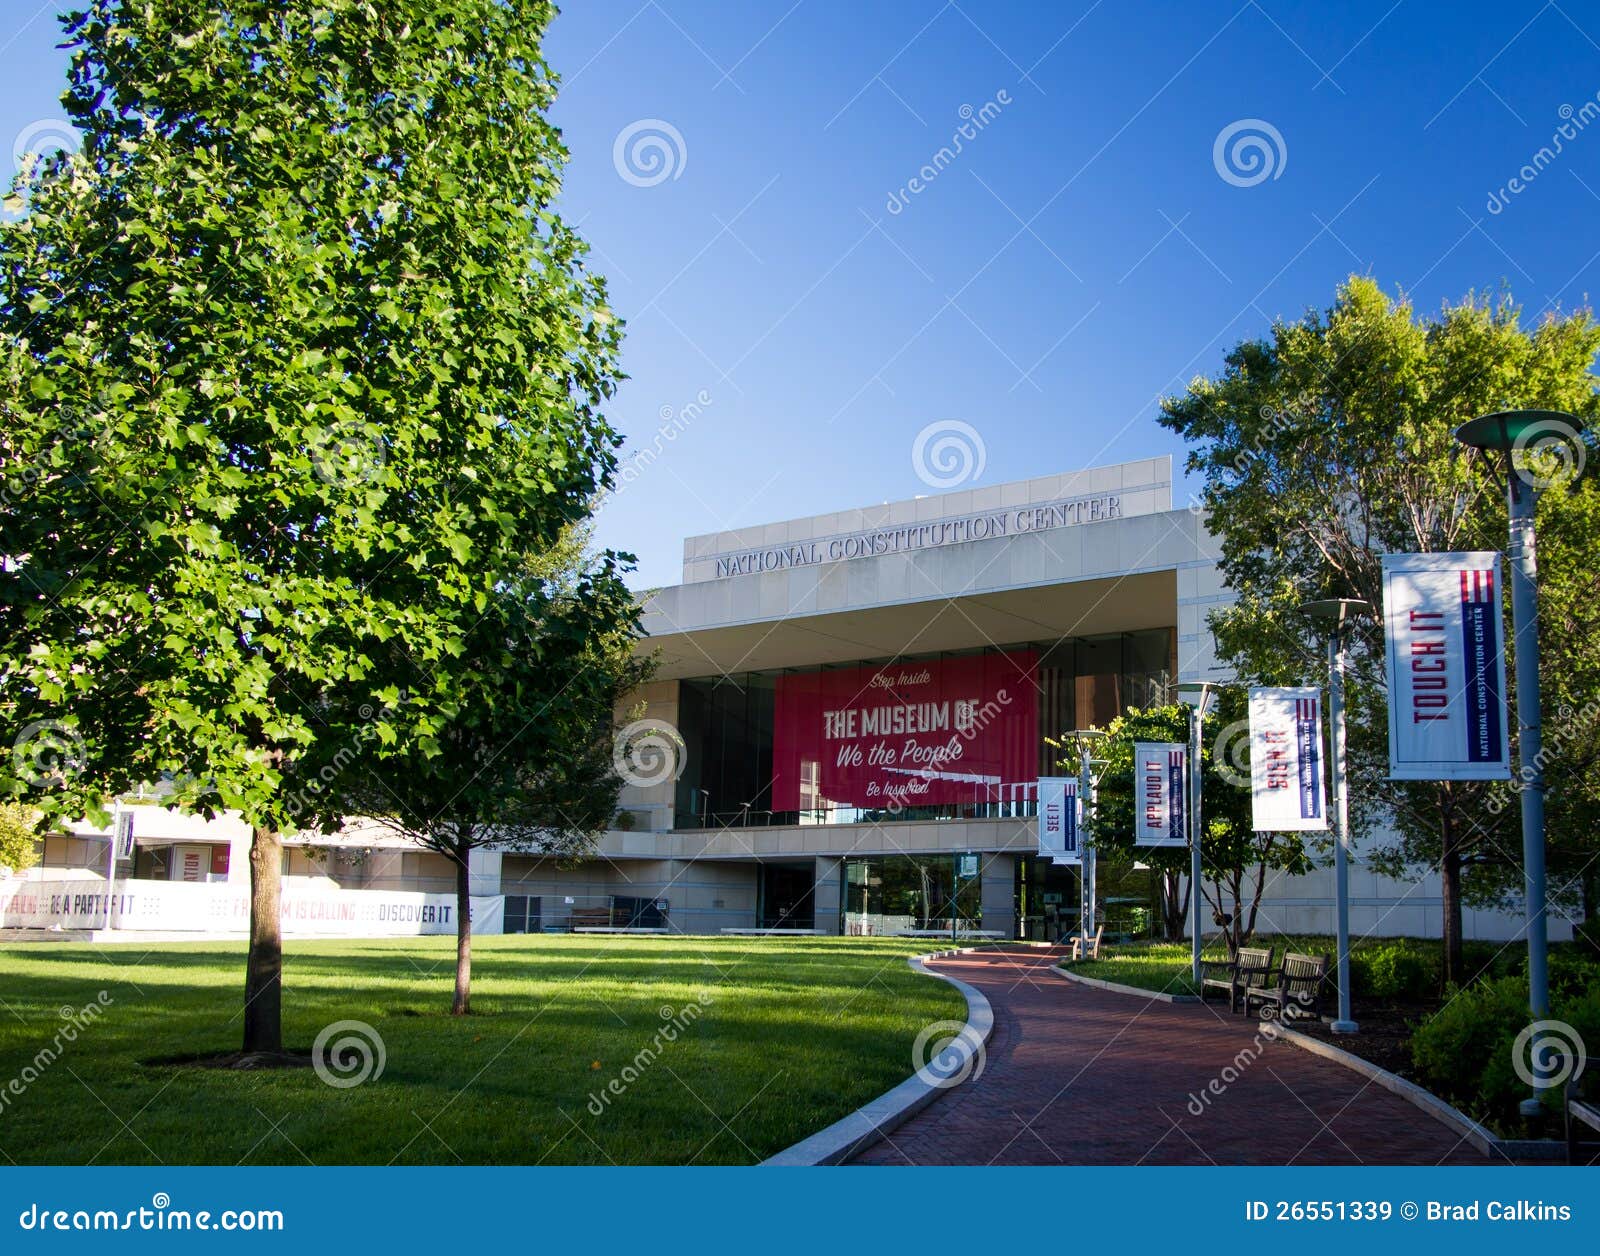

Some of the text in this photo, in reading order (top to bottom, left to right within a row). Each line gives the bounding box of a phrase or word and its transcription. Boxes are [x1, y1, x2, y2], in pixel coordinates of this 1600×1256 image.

[715, 496, 1123, 578] NATIONAL CONSTITUTION CENTER
[869, 669, 931, 690] Step Inside
[1409, 610, 1449, 724] TOUCH IT
[1473, 607, 1489, 757] NATIONAL CONSTITUTION CENTER
[823, 699, 981, 740] THE MUSEUM OF
[836, 736, 963, 769] We the People
[1265, 731, 1289, 789] SIGN IT
[866, 778, 931, 798] Be Inspired
[1146, 761, 1162, 829] APPLAUD IT
[1047, 804, 1059, 832] SEE IT
[51, 894, 61, 914] BE
[64, 894, 70, 914] A
[74, 894, 99, 914] PART
[120, 894, 135, 914] IT
[295, 901, 308, 920] IS
[310, 902, 356, 921] CALLING
[379, 903, 451, 923] DISCOVER IT
